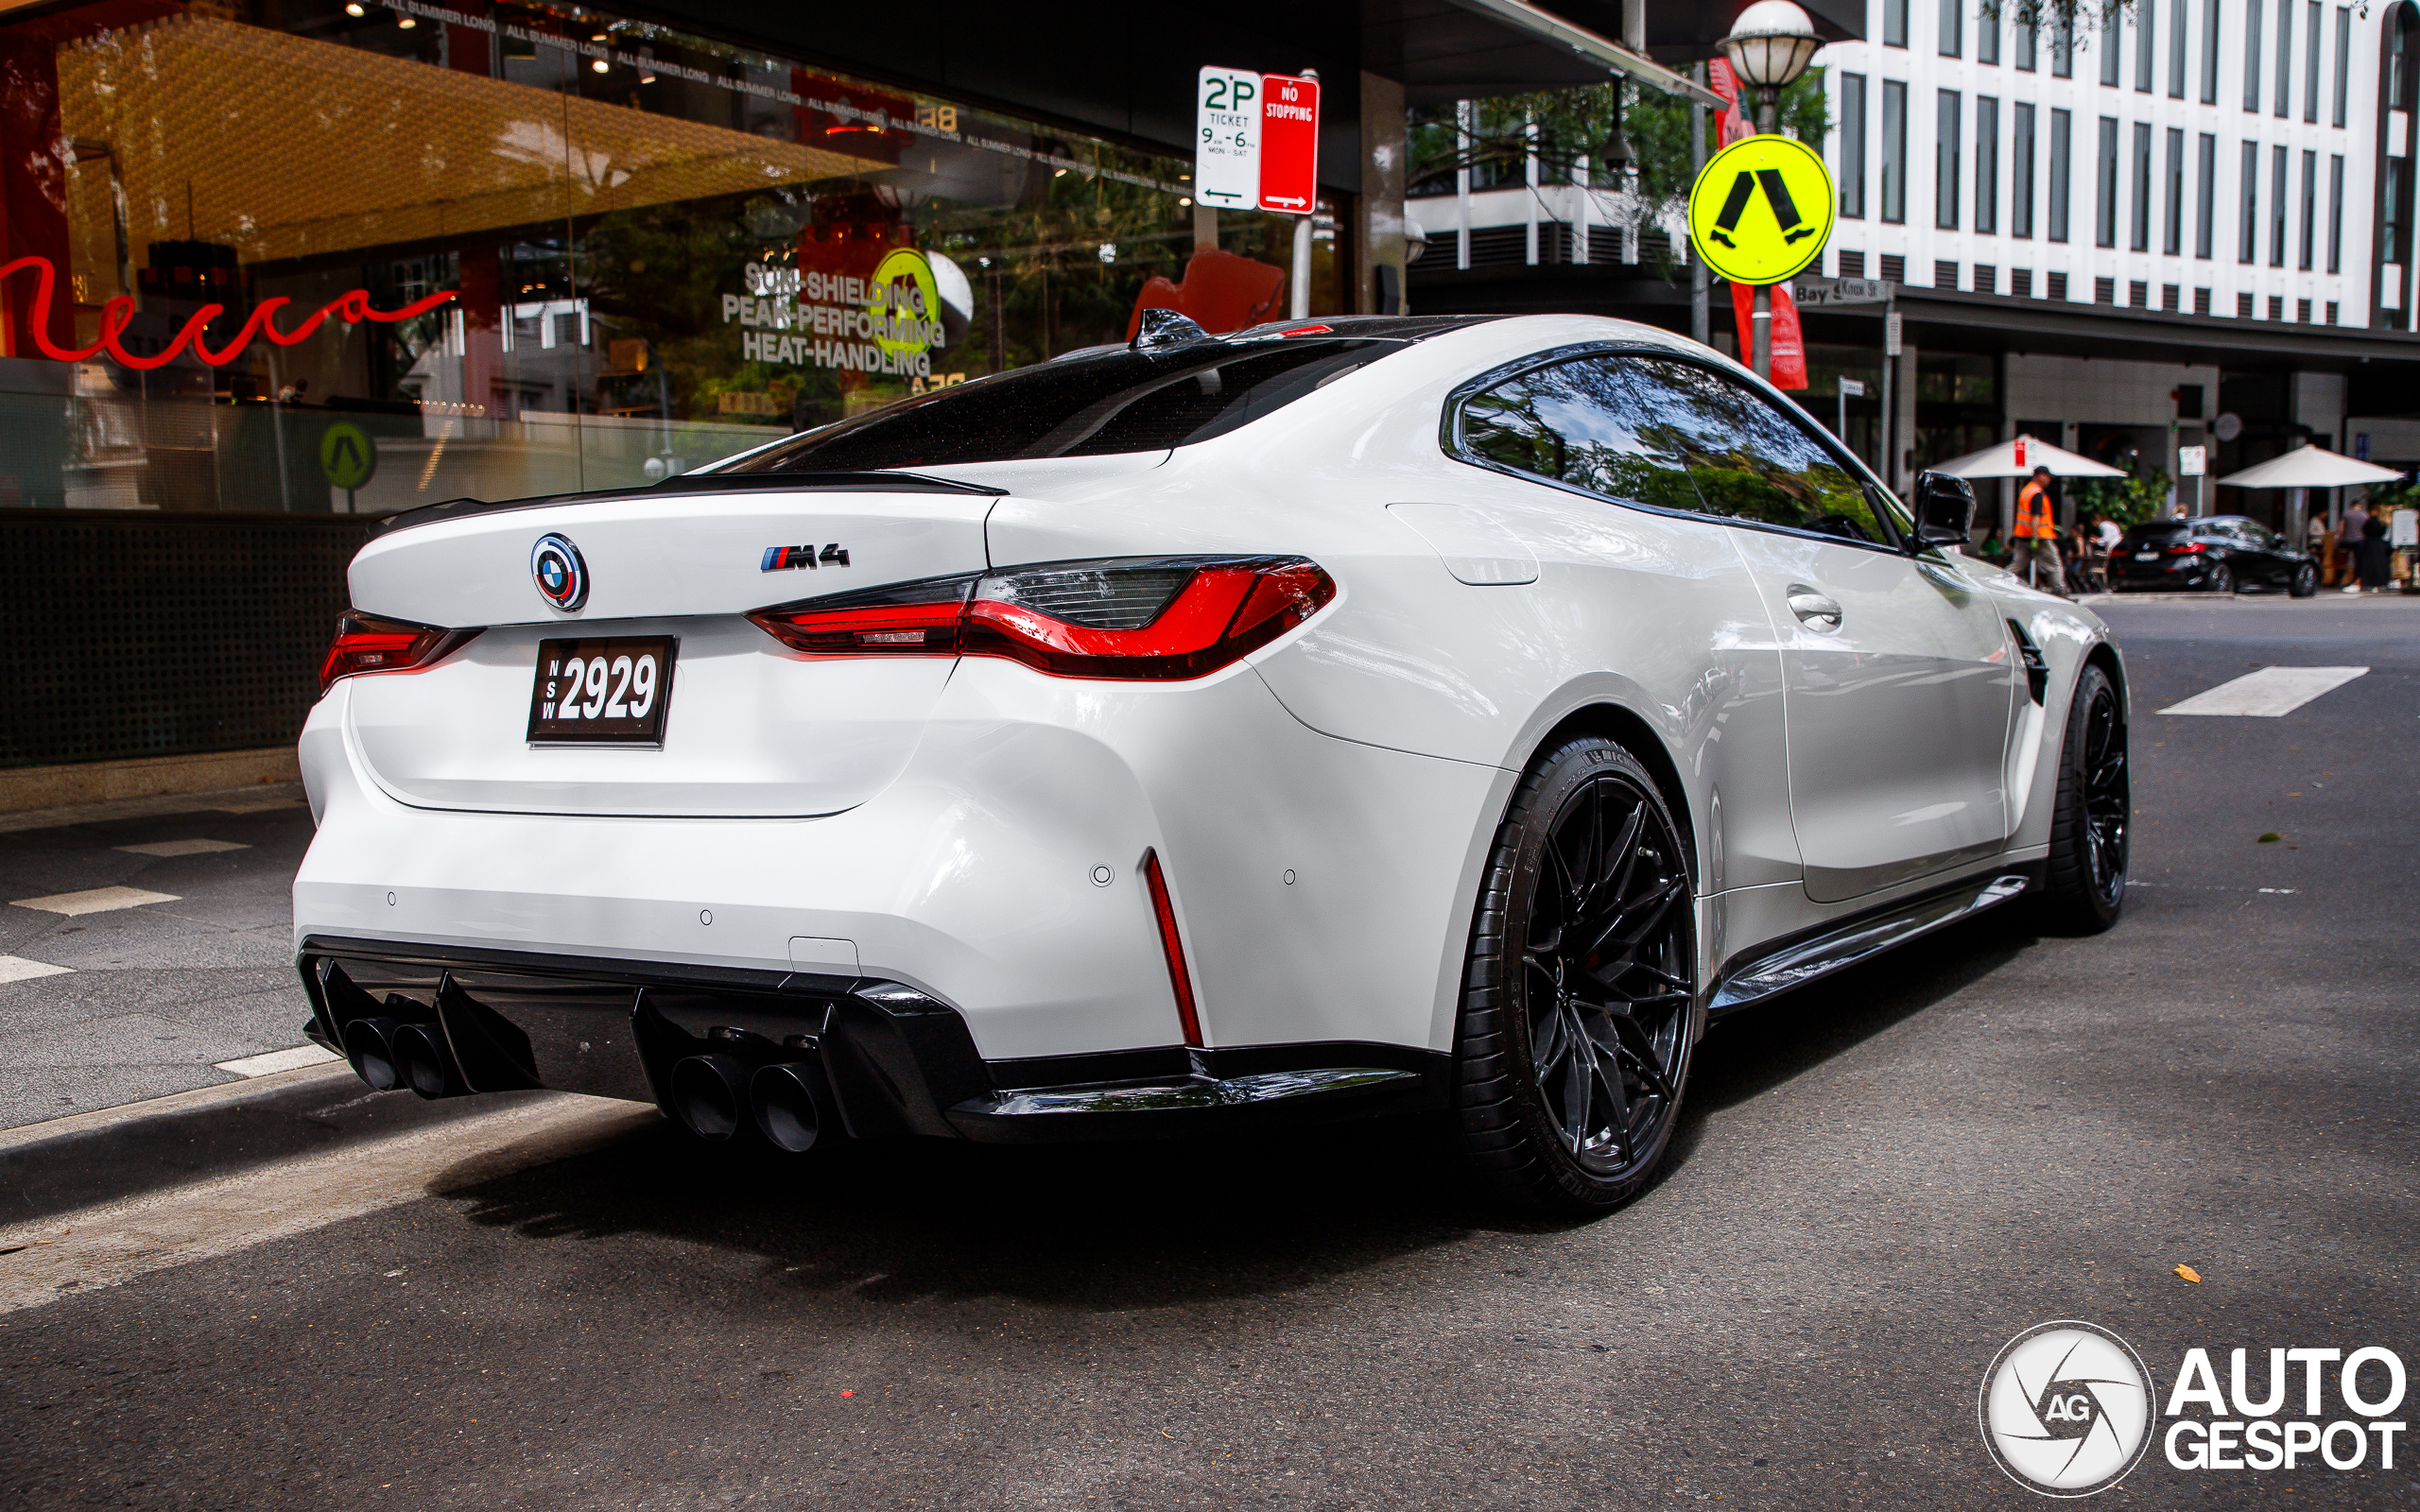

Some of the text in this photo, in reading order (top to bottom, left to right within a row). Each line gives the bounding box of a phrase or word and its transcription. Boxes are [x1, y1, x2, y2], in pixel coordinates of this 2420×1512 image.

[382, 0, 496, 32] ALL SUMMER LONG
[507, 24, 609, 59] ALL SUMMER LONG
[616, 51, 710, 83] ALL SUMMER LONG
[717, 75, 802, 105] ALL SUMMER LONG
[1205, 77, 1254, 112] 2P
[1282, 87, 1298, 102] NO
[807, 96, 886, 123] ALL SUMMER LONG
[1210, 113, 1249, 128] TICKET
[1266, 102, 1312, 122] STOPPING
[890, 116, 961, 143] ALL SUMMER LONG
[1201, 128, 1213, 144] 9
[1236, 131, 1246, 147] 6
[1208, 146, 1225, 155] MON
[744, 261, 925, 316] SUN-SHIELDING
[1796, 286, 1828, 305] Bay
[1841, 280, 1877, 297] Knox St
[721, 293, 946, 349] PEAK-PERFORMING
[743, 331, 931, 378] HEAT-HANDLING
[539, 552, 563, 567] BMW
[784, 542, 850, 570] M4
[558, 654, 657, 720] 2929
